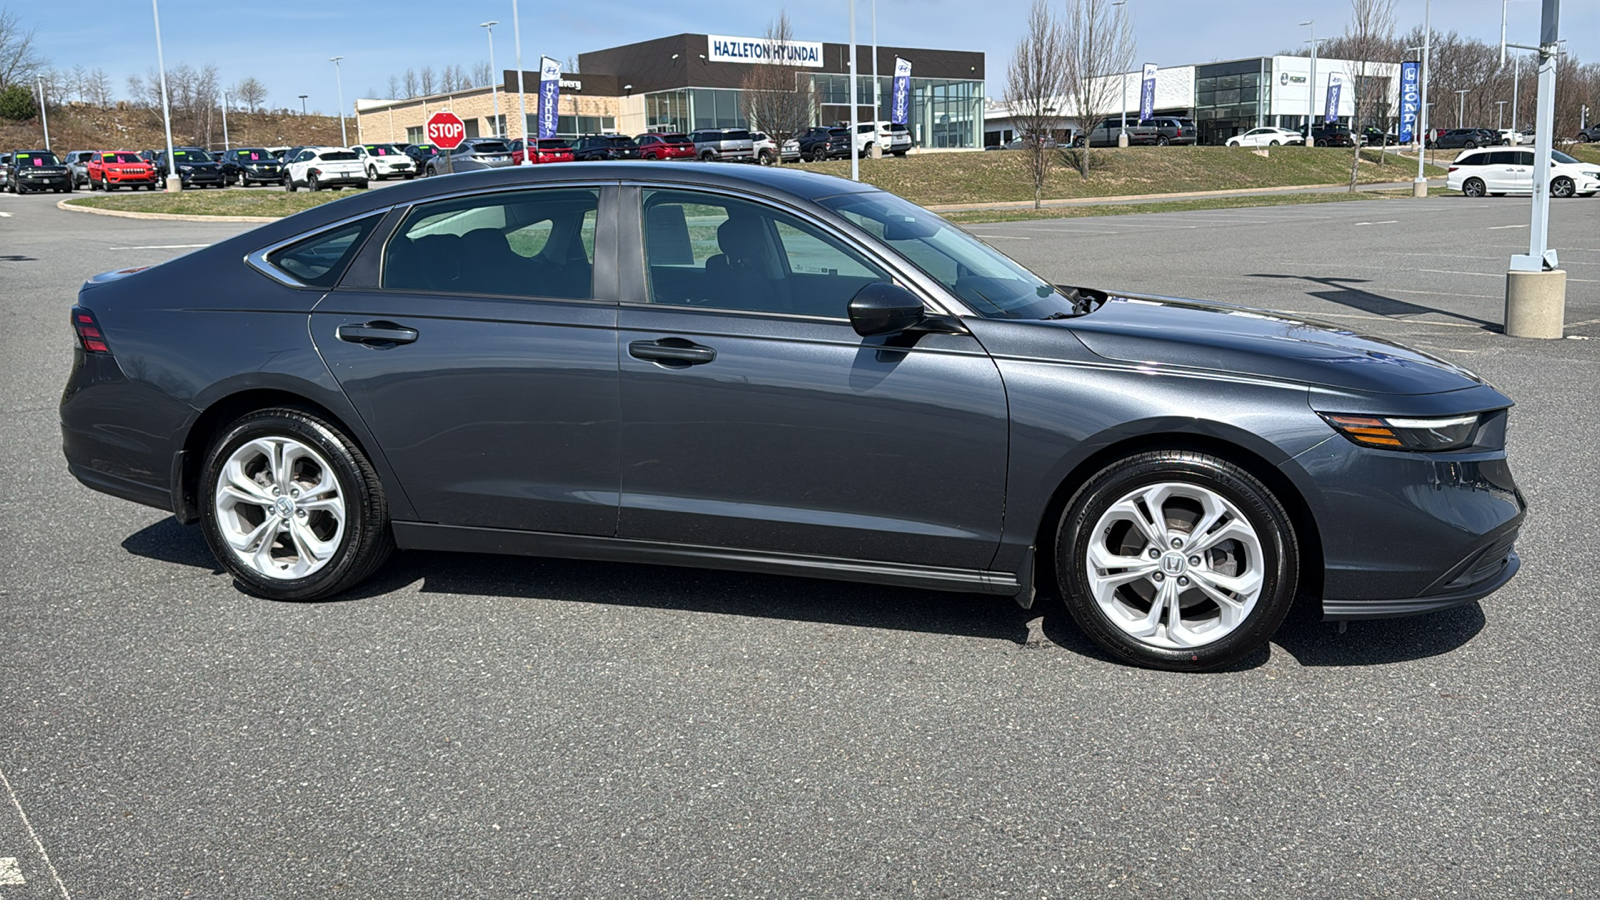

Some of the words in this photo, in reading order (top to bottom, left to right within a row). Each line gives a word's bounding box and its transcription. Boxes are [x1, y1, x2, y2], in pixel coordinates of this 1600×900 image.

[714, 40, 770, 59] HAZLETON
[773, 44, 818, 62] HYUNDAI
[544, 82, 554, 136] HYUNDAI
[896, 78, 906, 123] HYUNDAI
[1402, 83, 1417, 133] HONDA
[429, 123, 462, 138] STOP
